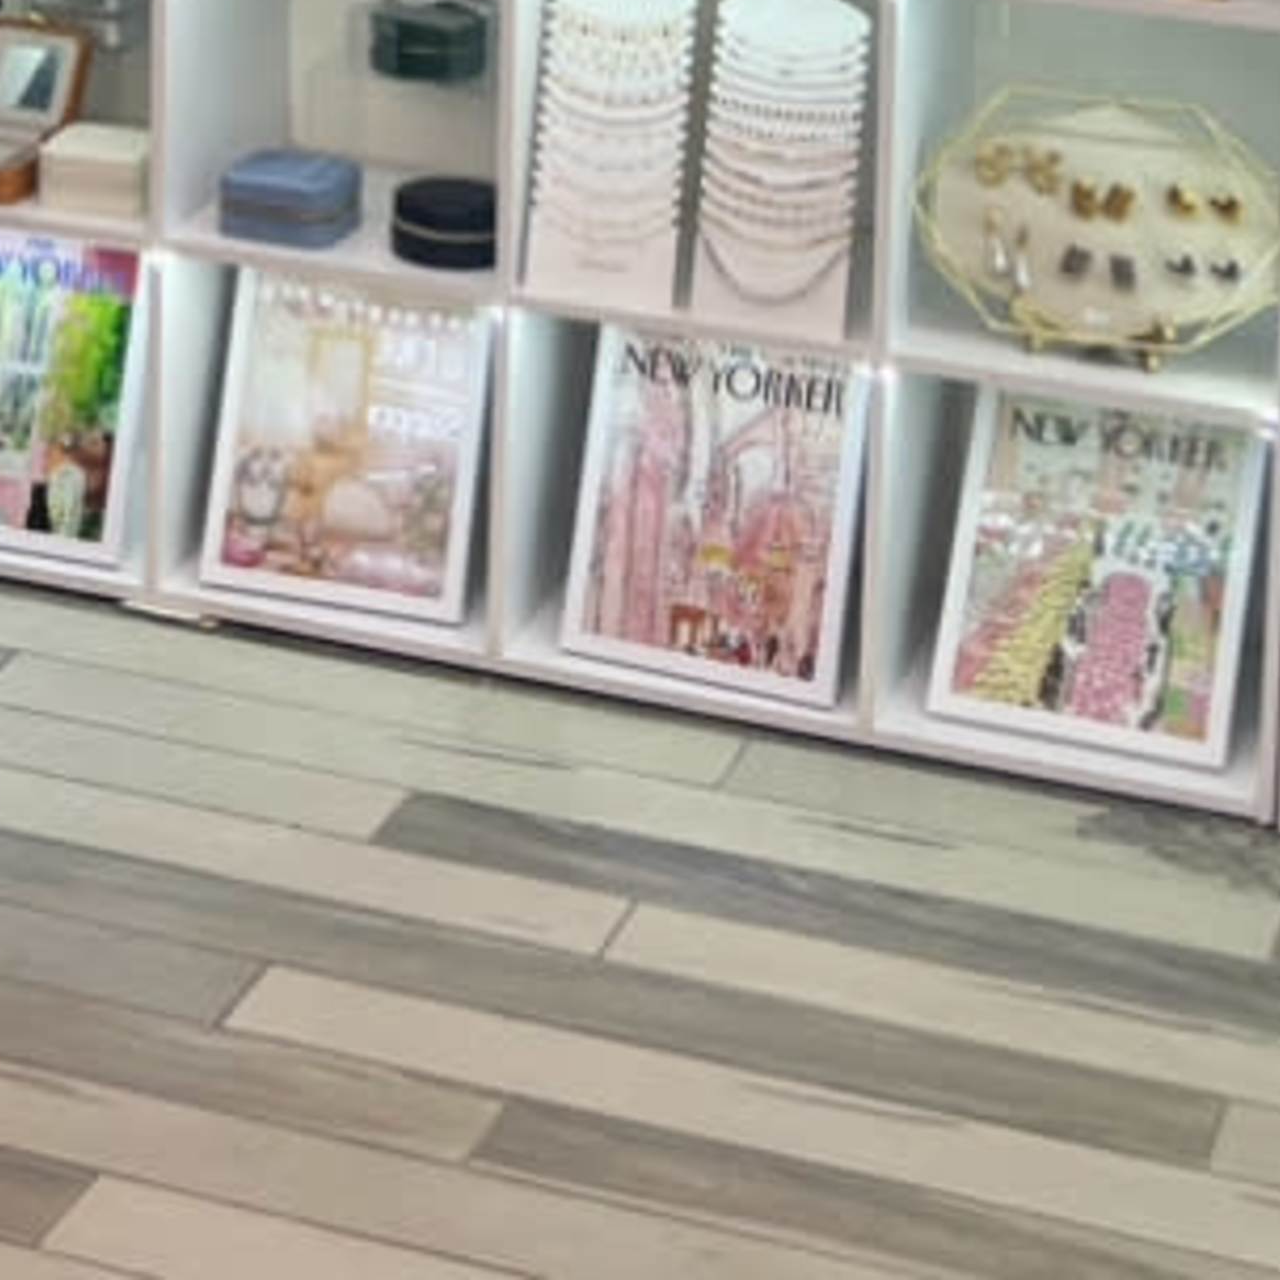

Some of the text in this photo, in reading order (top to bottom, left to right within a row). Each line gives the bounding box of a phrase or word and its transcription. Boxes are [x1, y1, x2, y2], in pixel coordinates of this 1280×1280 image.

[621, 342, 702, 390] NEW
[709, 359, 846, 418] YORKER
[1011, 407, 1090, 449] NEW
